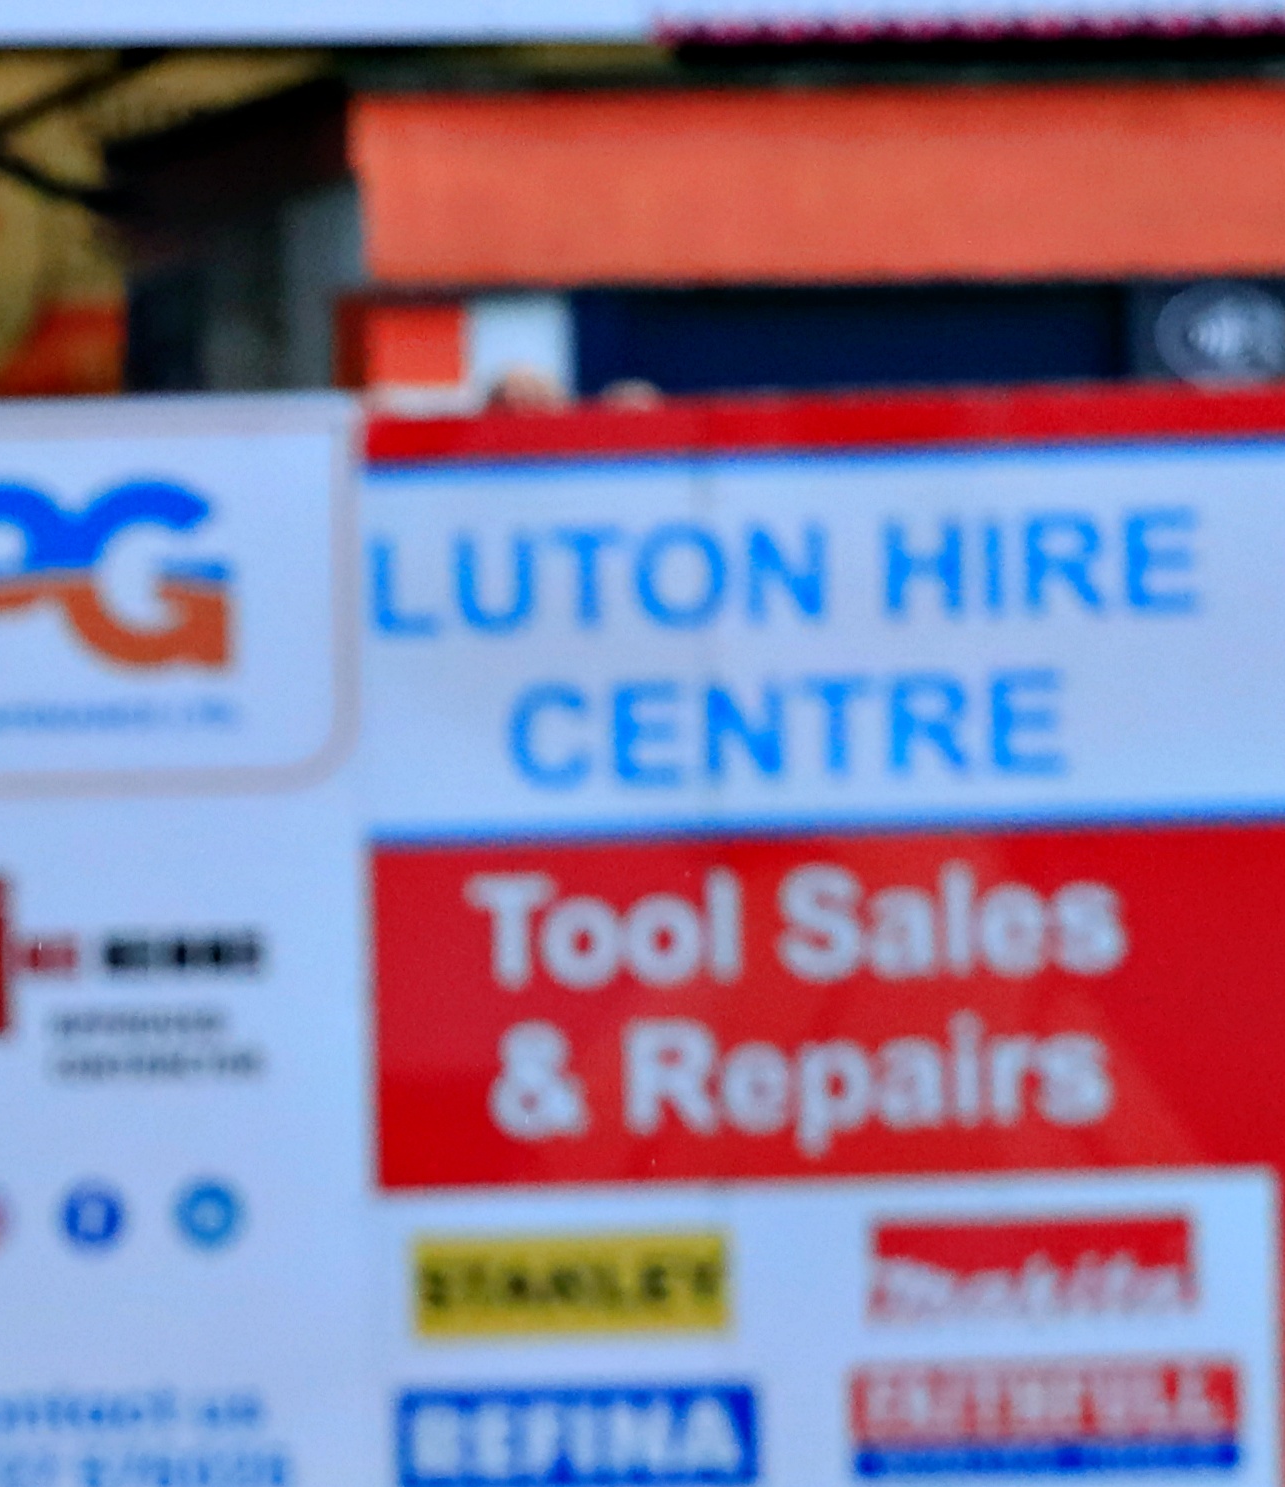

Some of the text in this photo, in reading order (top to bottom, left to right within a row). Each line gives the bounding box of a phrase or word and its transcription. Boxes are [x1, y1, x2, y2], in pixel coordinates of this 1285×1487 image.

[368, 505, 1200, 638] LUTON HIRE
[508, 668, 1067, 790] CENTRE
[464, 859, 1128, 991] Tool Sales
[487, 1009, 1115, 1160] & Repairs
[412, 1395, 743, 1476] REFINA
